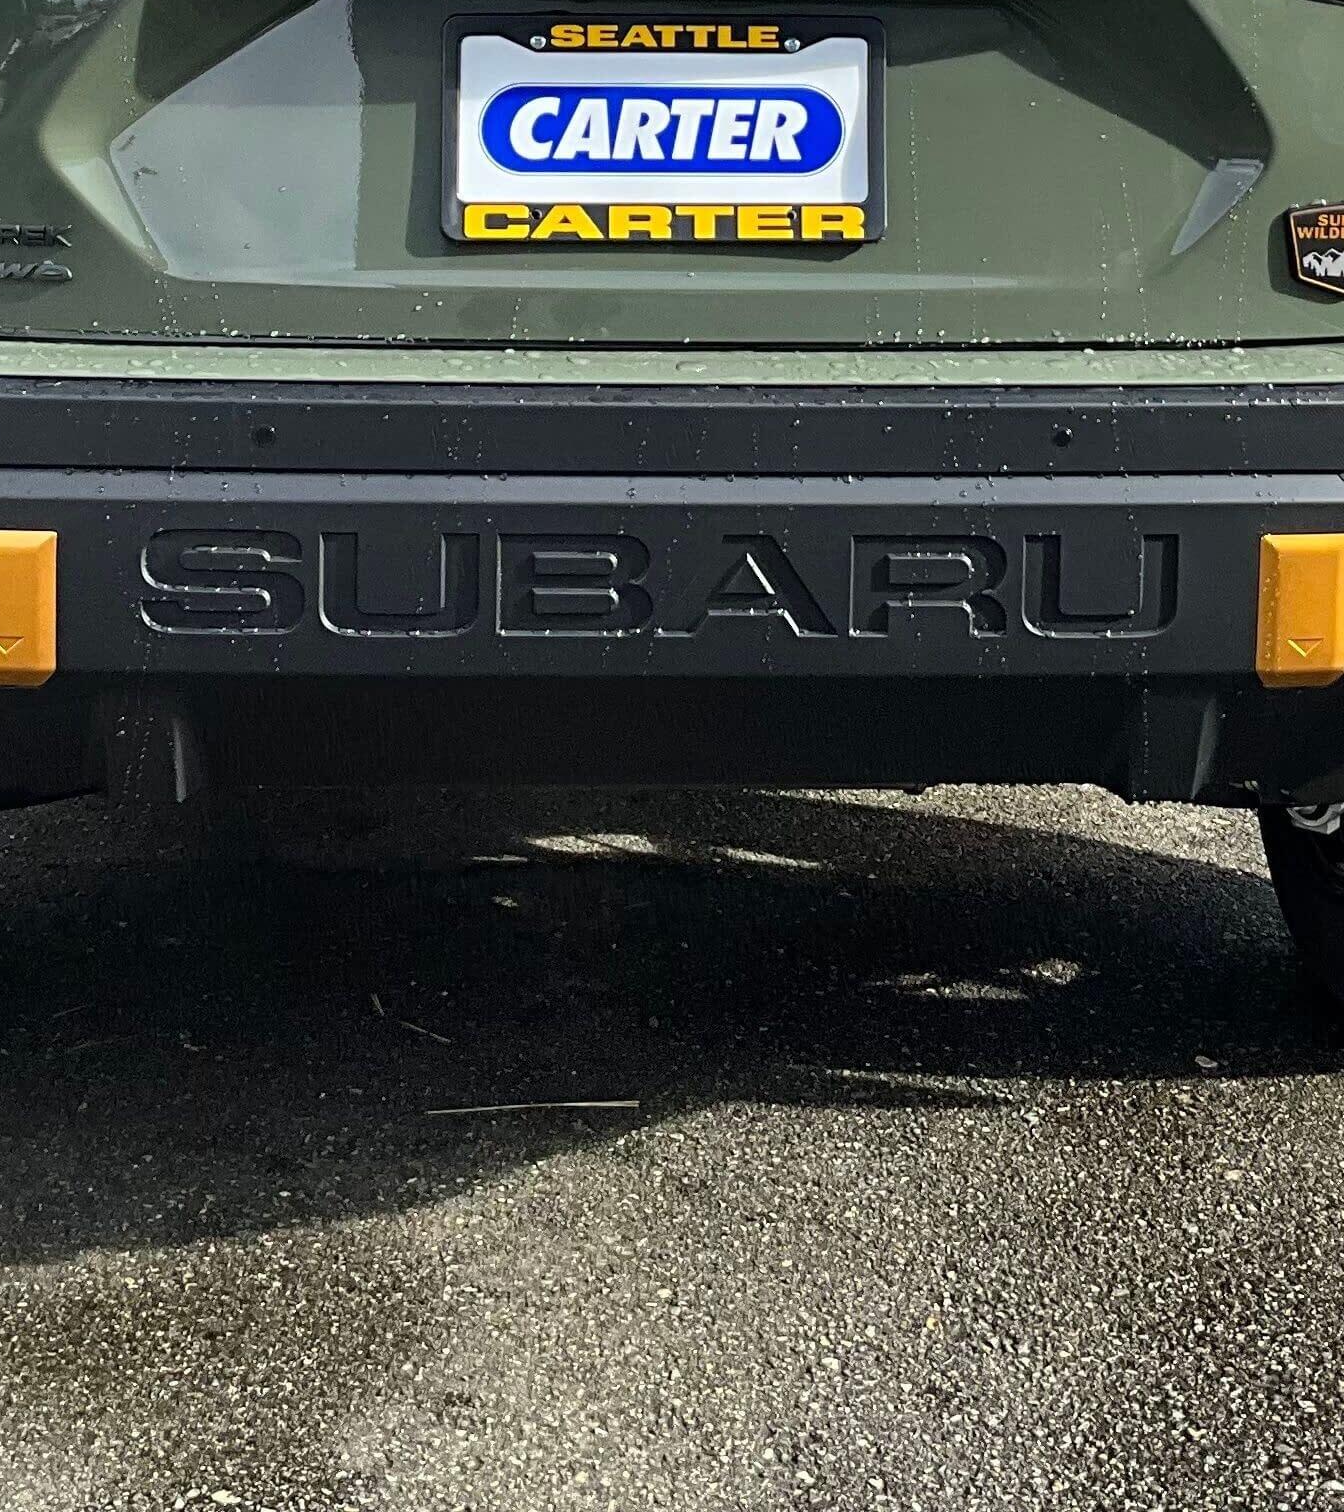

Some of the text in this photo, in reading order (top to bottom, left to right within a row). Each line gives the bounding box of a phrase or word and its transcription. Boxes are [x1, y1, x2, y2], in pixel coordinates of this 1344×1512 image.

[550, 24, 780, 49] SEATTLE
[509, 96, 809, 161] CARTER
[463, 204, 866, 240] CARTER
[138, 528, 1181, 639] SUBARU
